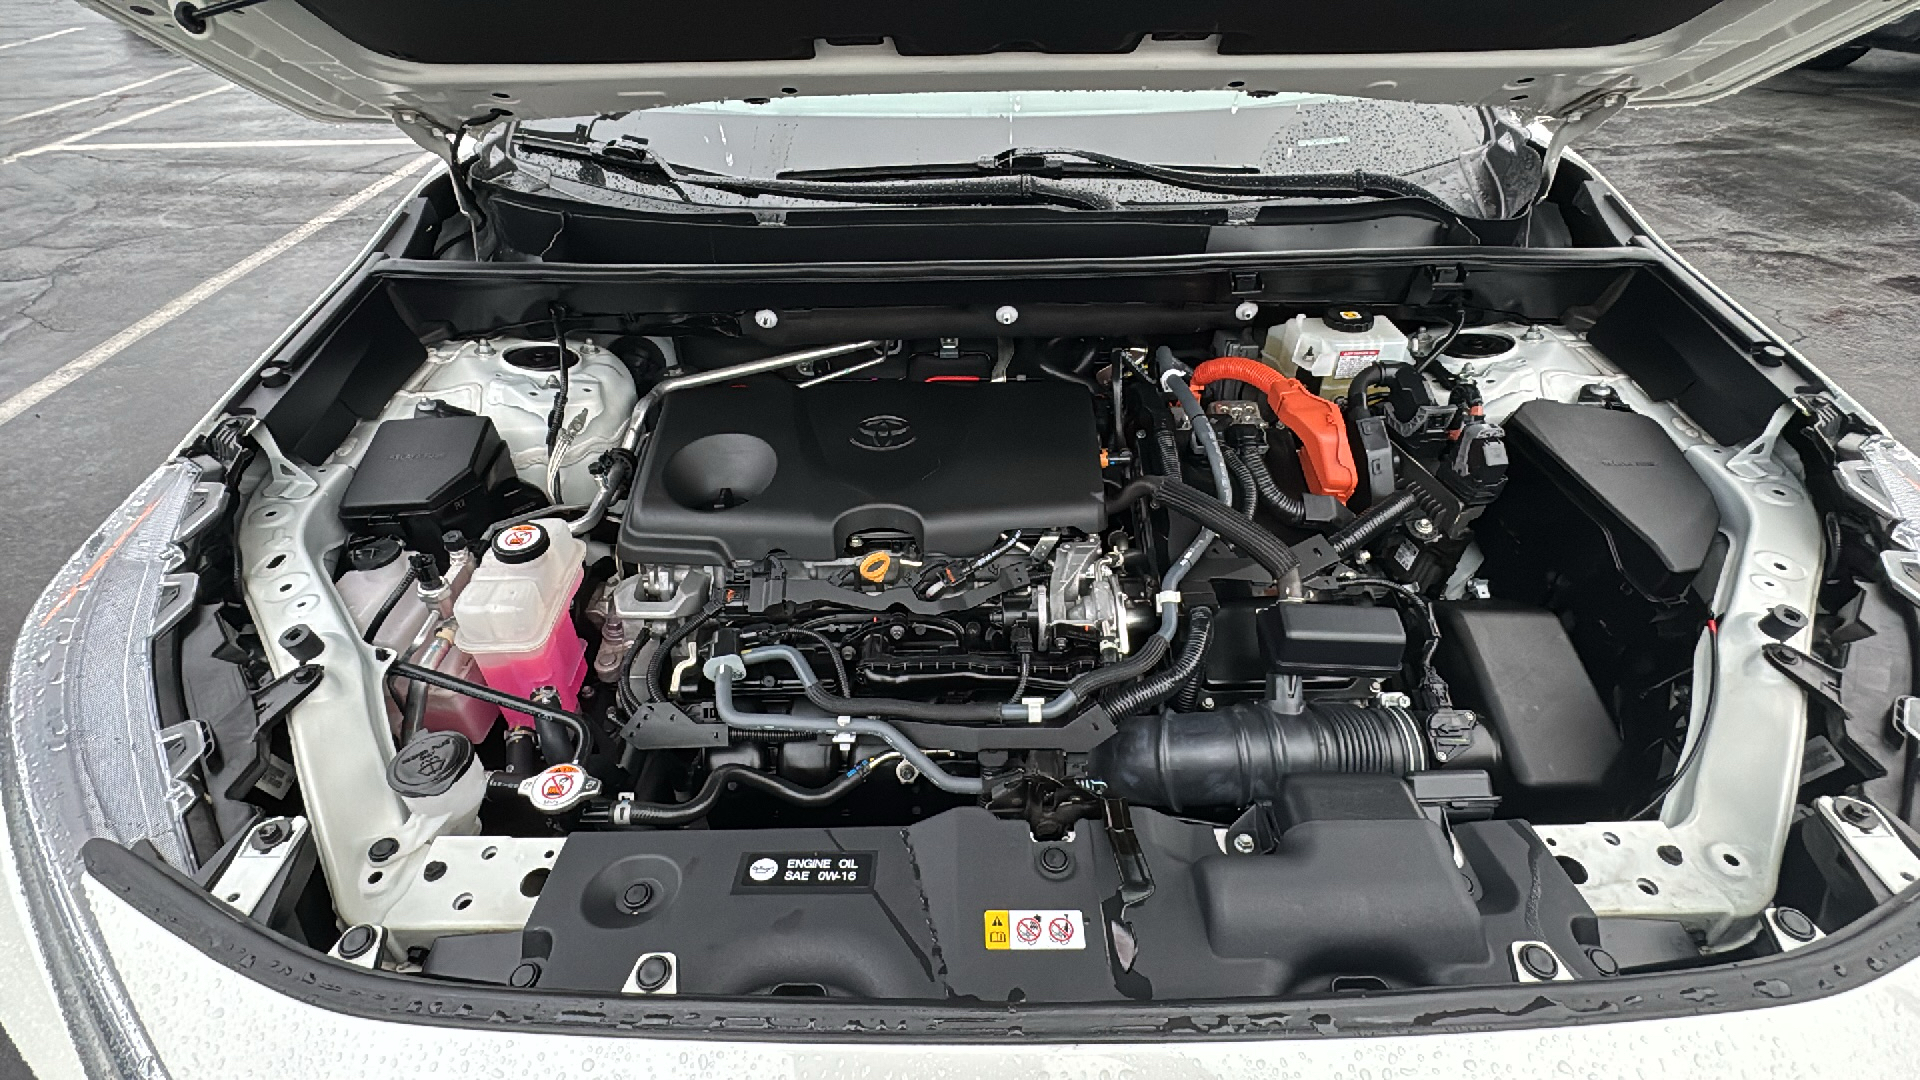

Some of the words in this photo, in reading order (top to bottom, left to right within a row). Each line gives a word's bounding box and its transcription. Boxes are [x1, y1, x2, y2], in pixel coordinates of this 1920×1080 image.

[787, 858, 832, 869] ENGINE
[838, 858, 859, 869] OIL
[784, 870, 810, 881] SAE
[817, 870, 857, 881] 0W-16
